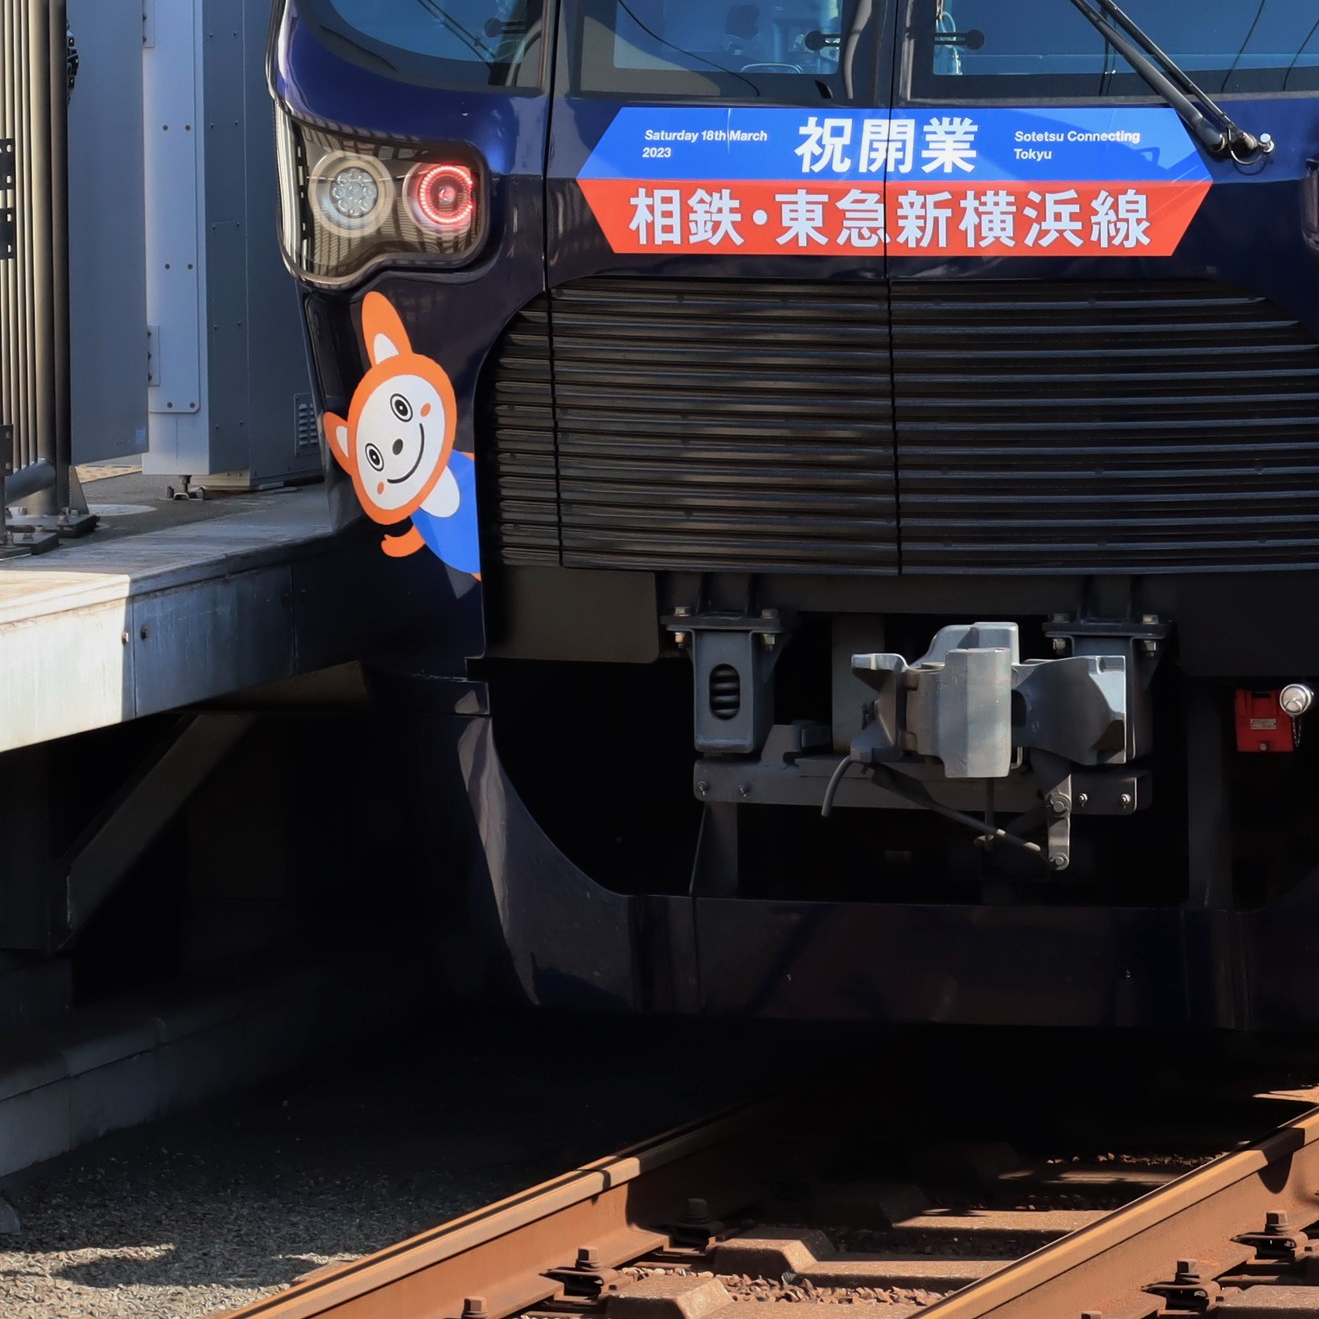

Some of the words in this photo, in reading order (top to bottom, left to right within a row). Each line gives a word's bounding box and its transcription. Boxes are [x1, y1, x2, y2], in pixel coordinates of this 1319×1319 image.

[644, 129, 699, 143] Saturday
[701, 129, 727, 141] 18th
[729, 129, 768, 141] March
[1014, 130, 1065, 142] Sotetsu
[1067, 130, 1141, 144] Connecting
[793, 116, 979, 174] 祝開業
[641, 147, 672, 158] 2023
[1013, 148, 1053, 162] Tokyu
[628, 186, 1152, 249] 相鉄・東急新横浜線
